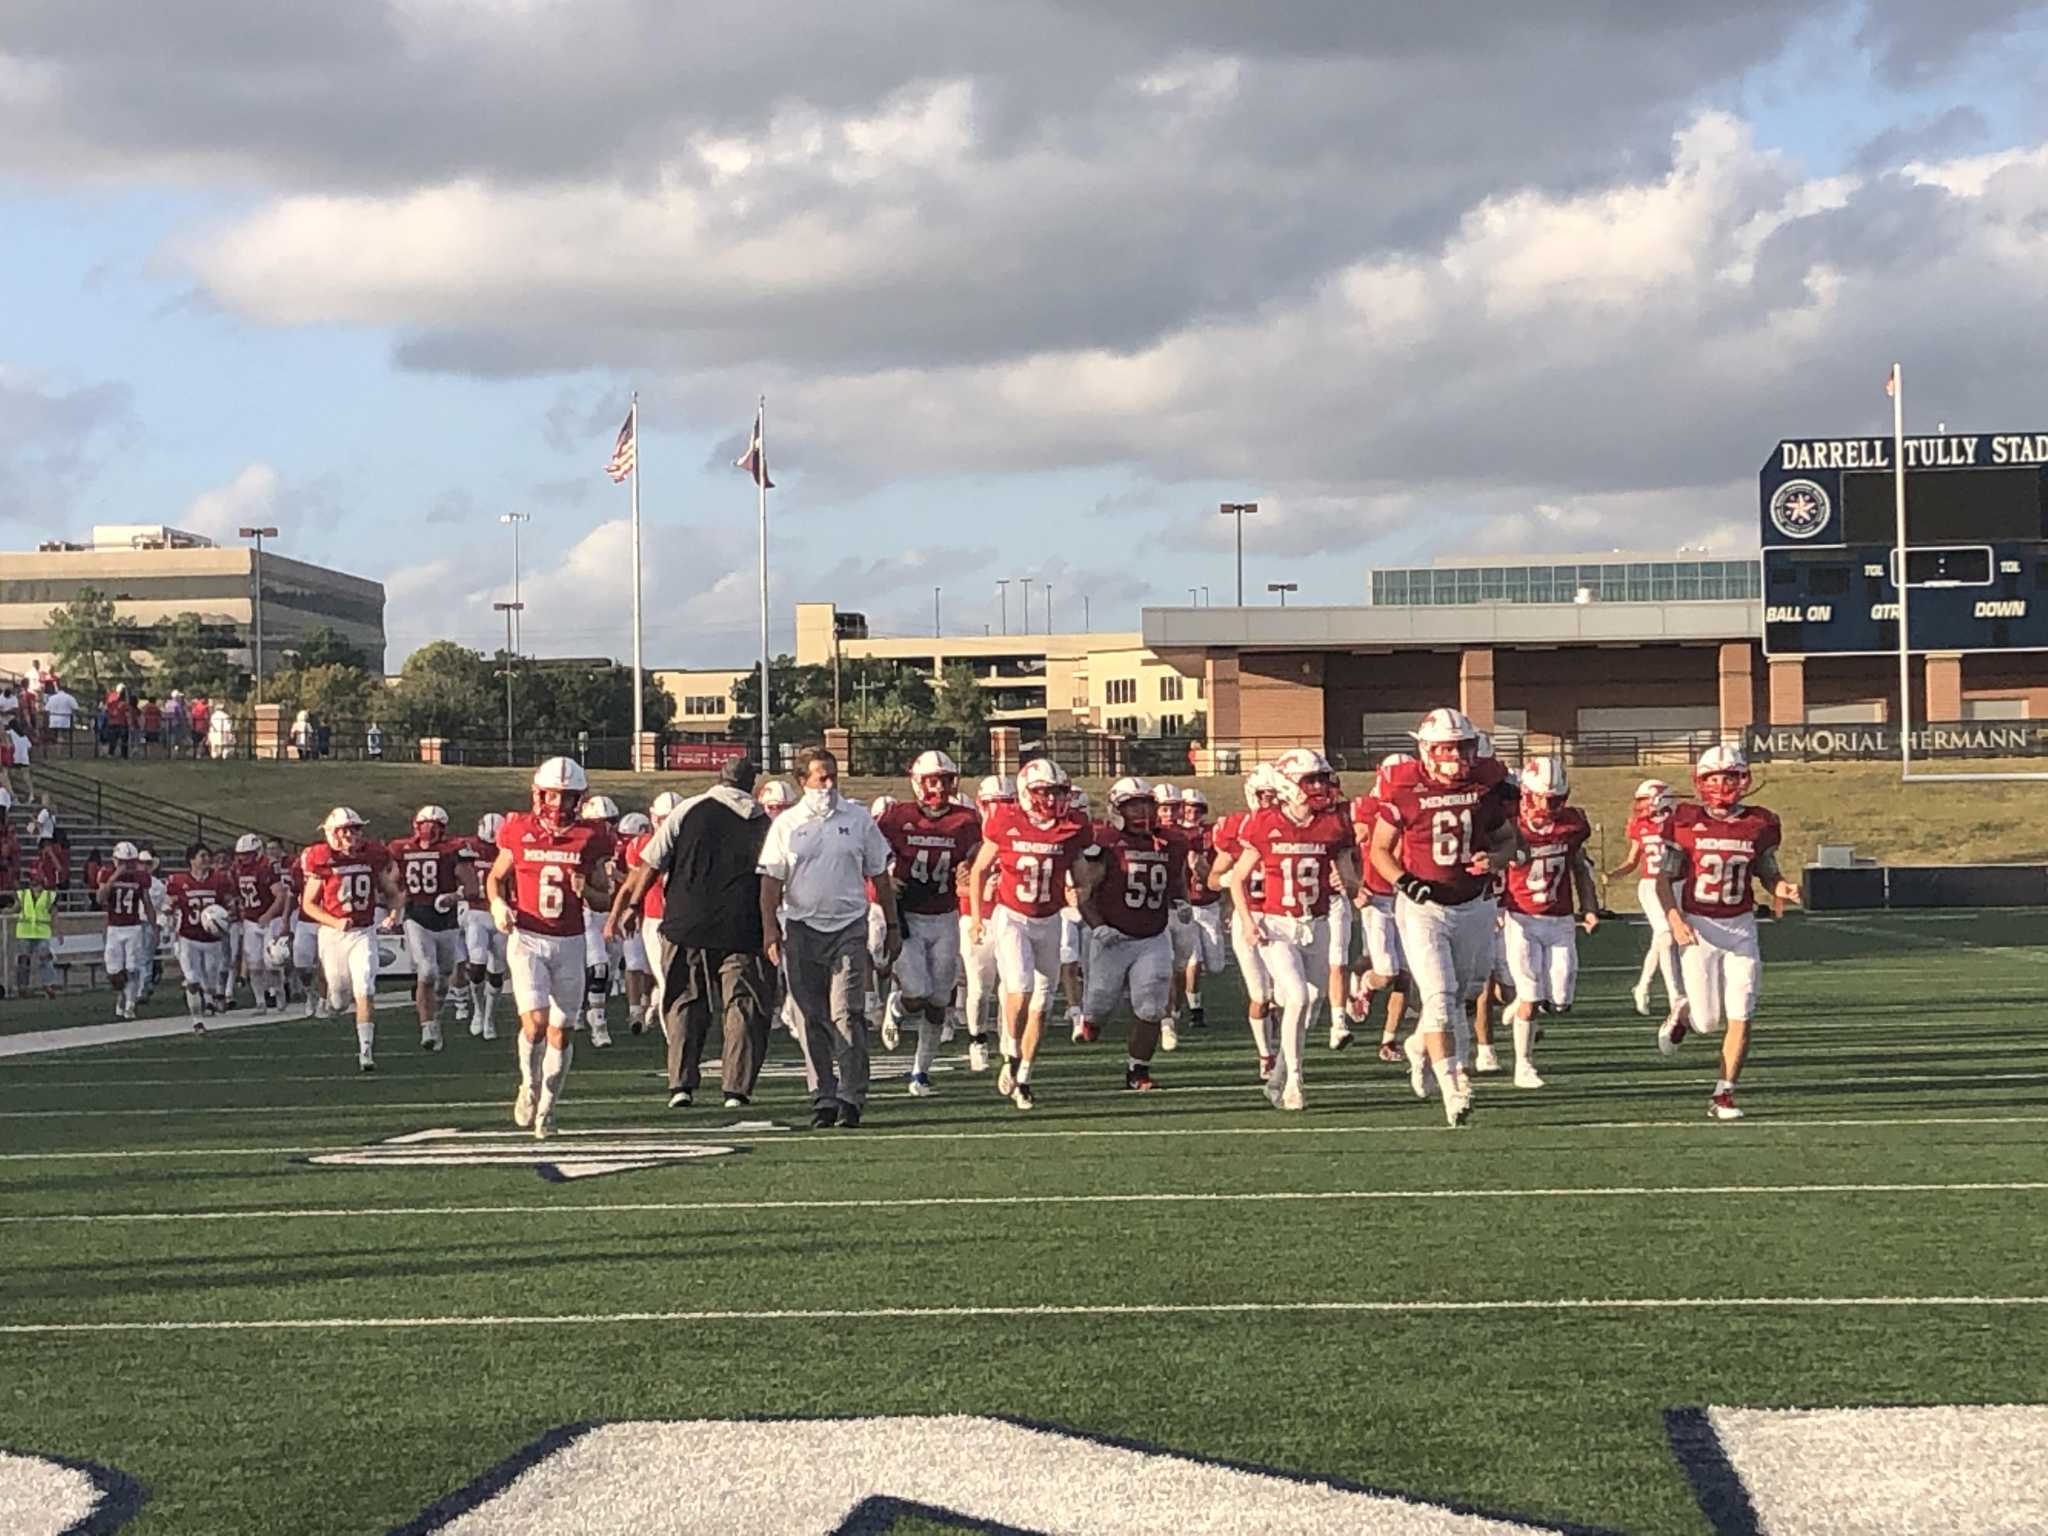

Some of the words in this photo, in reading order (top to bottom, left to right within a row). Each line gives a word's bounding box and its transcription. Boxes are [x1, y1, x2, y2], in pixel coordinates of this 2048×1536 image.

[1781, 440, 1888, 469] DARRELL
[1904, 438, 1978, 466] TULLY
[1992, 436, 2048, 463] STAD
[1766, 606, 1803, 622] BALL
[1806, 605, 1832, 621] ON
[1974, 601, 2026, 618] DOWN
[1753, 730, 1888, 754] MEMORIAL
[1901, 728, 2026, 750] HERMANN
[1432, 809, 1472, 866] 61
[406, 860, 437, 894] 68
[539, 865, 563, 918] 6
[911, 850, 951, 894] 44
[1016, 856, 1053, 903] 31
[1125, 862, 1167, 909] 59
[1280, 857, 1319, 907] 19
[1695, 854, 1750, 905] 20
[115, 888, 134, 914] 14
